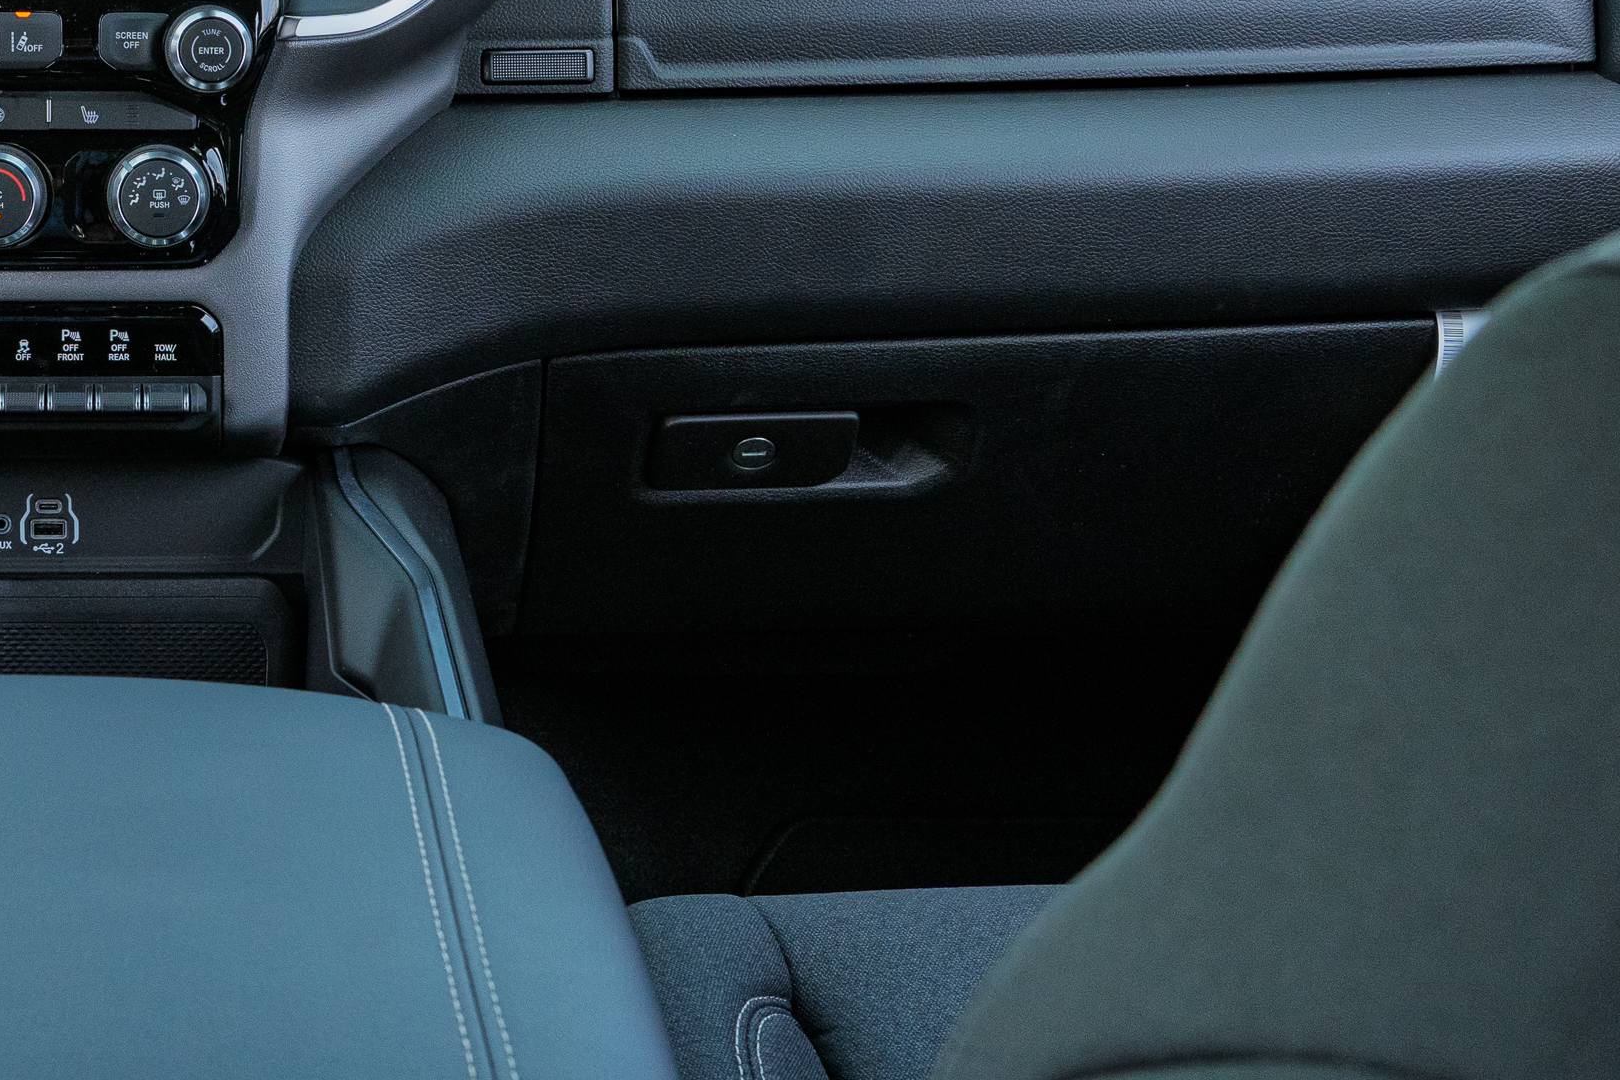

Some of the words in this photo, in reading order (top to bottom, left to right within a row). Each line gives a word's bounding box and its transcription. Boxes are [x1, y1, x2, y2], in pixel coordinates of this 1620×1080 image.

[115, 31, 149, 40] SCREEN
[201, 28, 222, 38] TUNE
[27, 44, 43, 52] OFF
[123, 41, 140, 49] OFF
[198, 46, 225, 55] ENTER
[198, 62, 226, 73] SCROLL
[149, 201, 170, 209] PUSH
[62, 344, 79, 352] OFF
[110, 344, 127, 352] OFF
[154, 344, 177, 353] TOW/
[15, 353, 32, 362] OFF
[57, 353, 84, 361] FRONT
[108, 353, 130, 361] REAR
[155, 353, 177, 361] HAUL
[55, 543, 64, 554] 2
